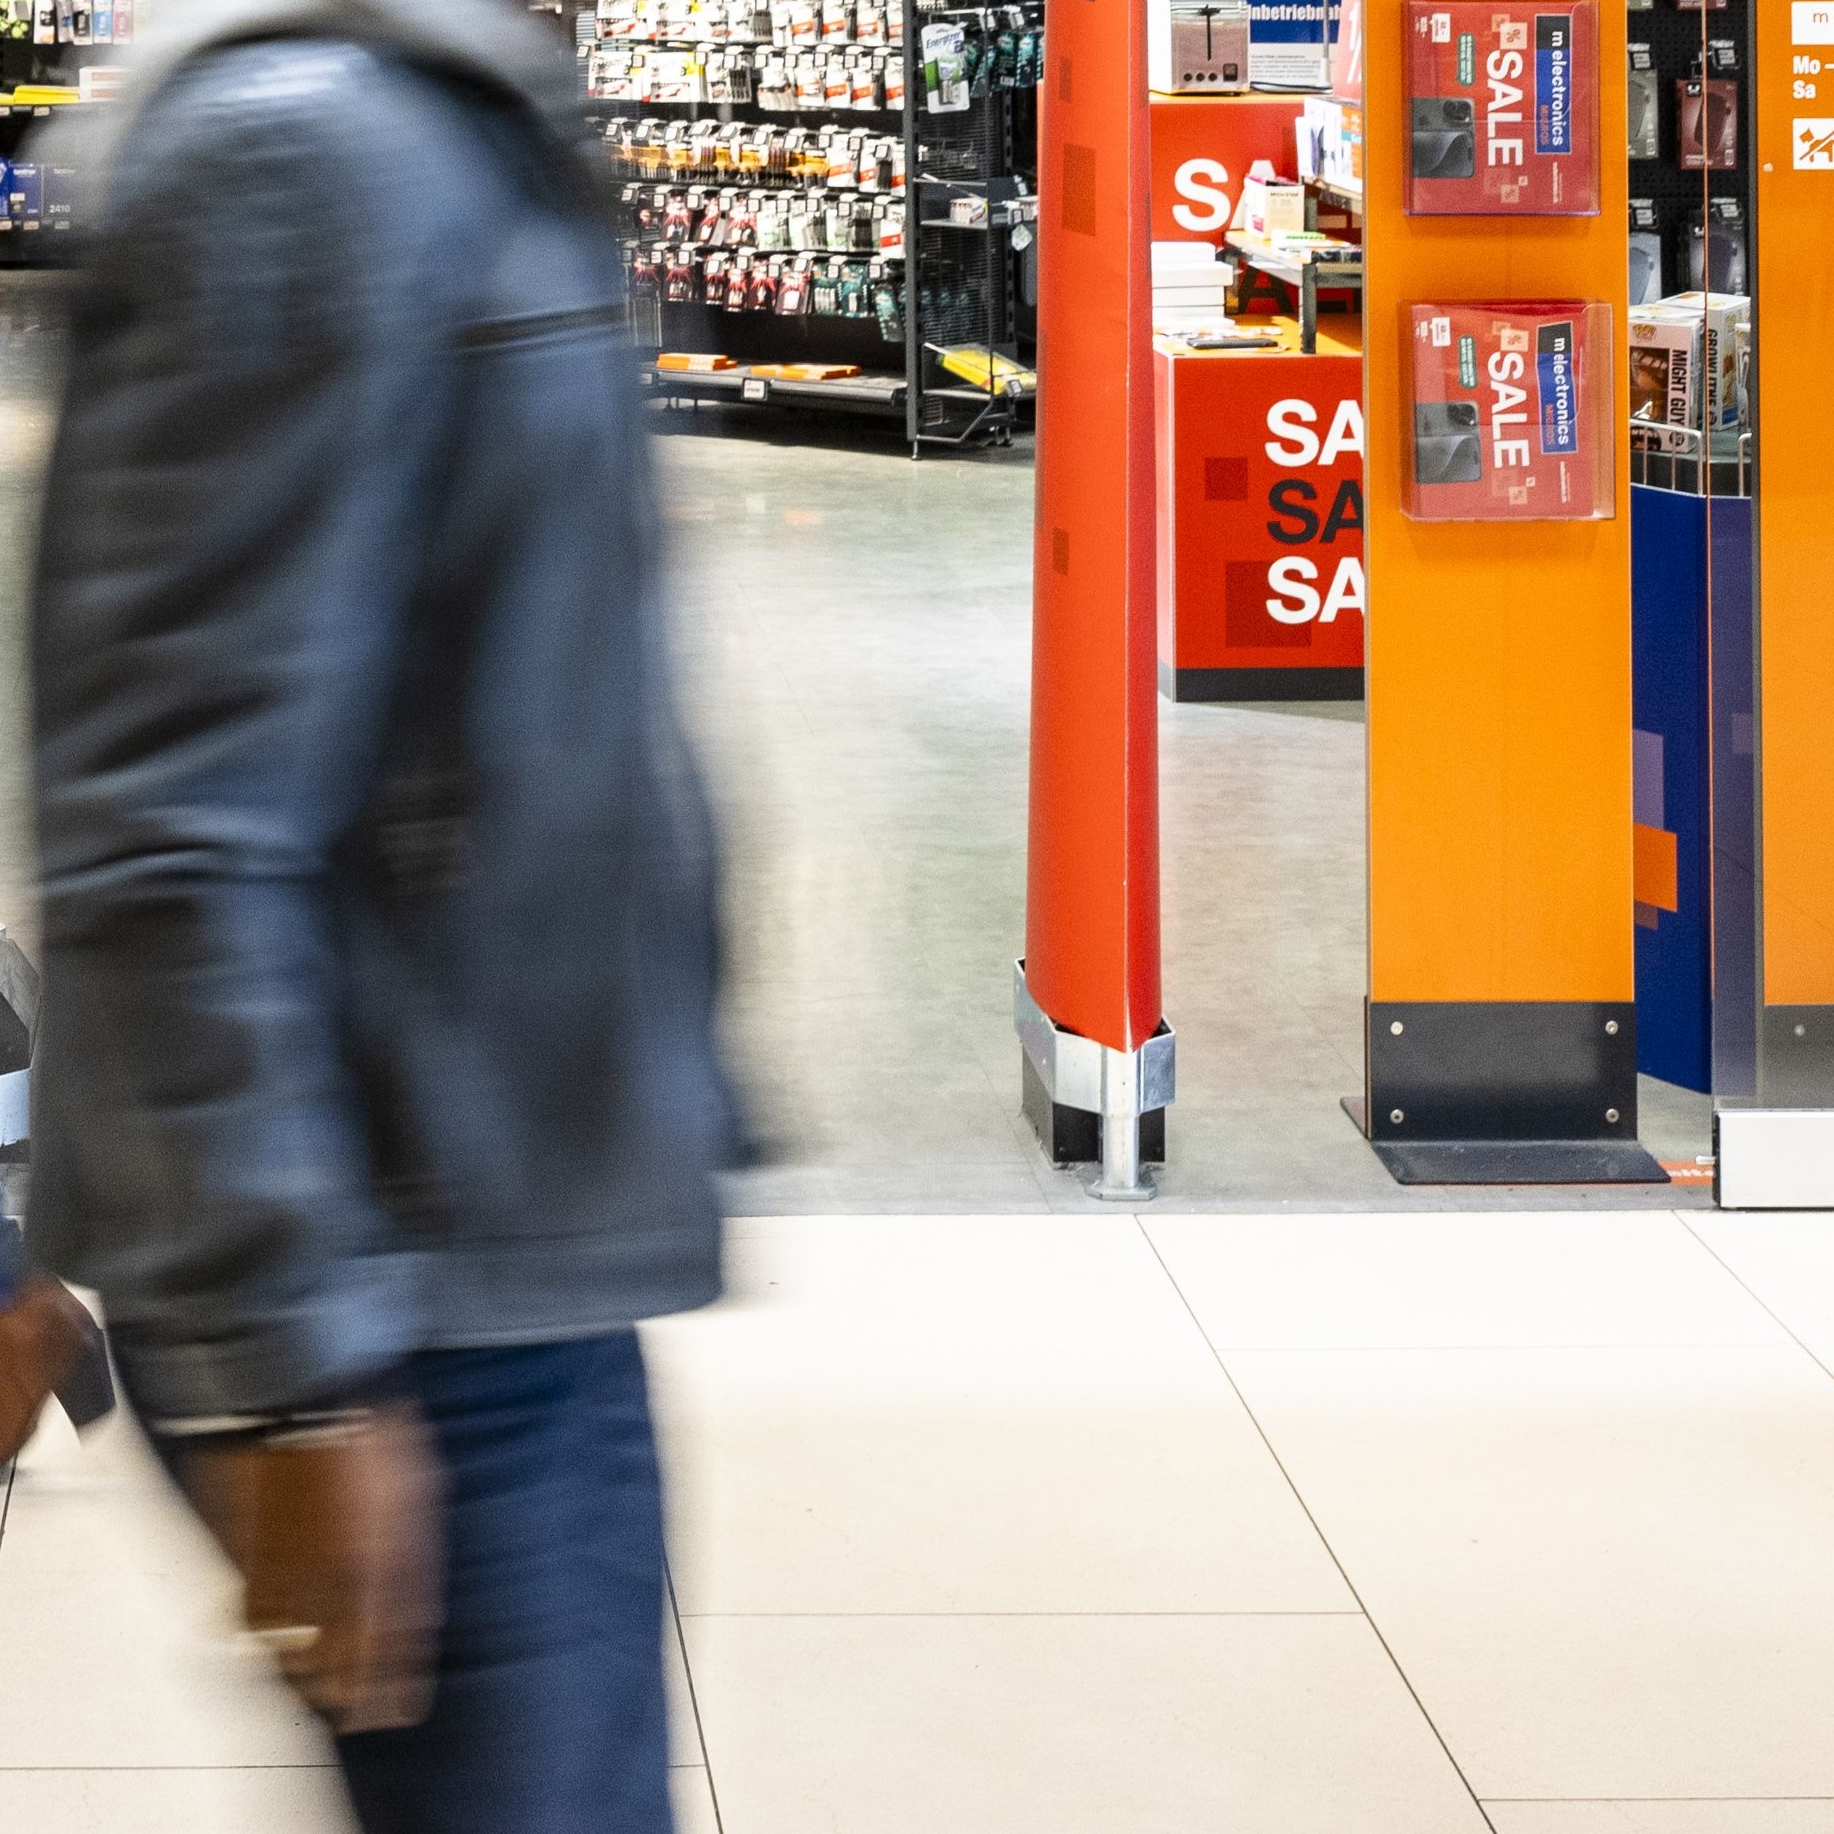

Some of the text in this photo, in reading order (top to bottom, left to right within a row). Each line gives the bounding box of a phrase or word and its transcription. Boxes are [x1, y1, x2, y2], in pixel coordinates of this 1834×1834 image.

[1813, 11, 1829, 24] m
[1551, 50, 1569, 146] electronics
[1792, 55, 1821, 75] Mo
[1792, 80, 1817, 99] Sa
[1486, 50, 1524, 166] SALE
[1487, 351, 1530, 469] SALE
[1553, 353, 1570, 446] electronics
[1669, 349, 1688, 426] MIGHT GUY
